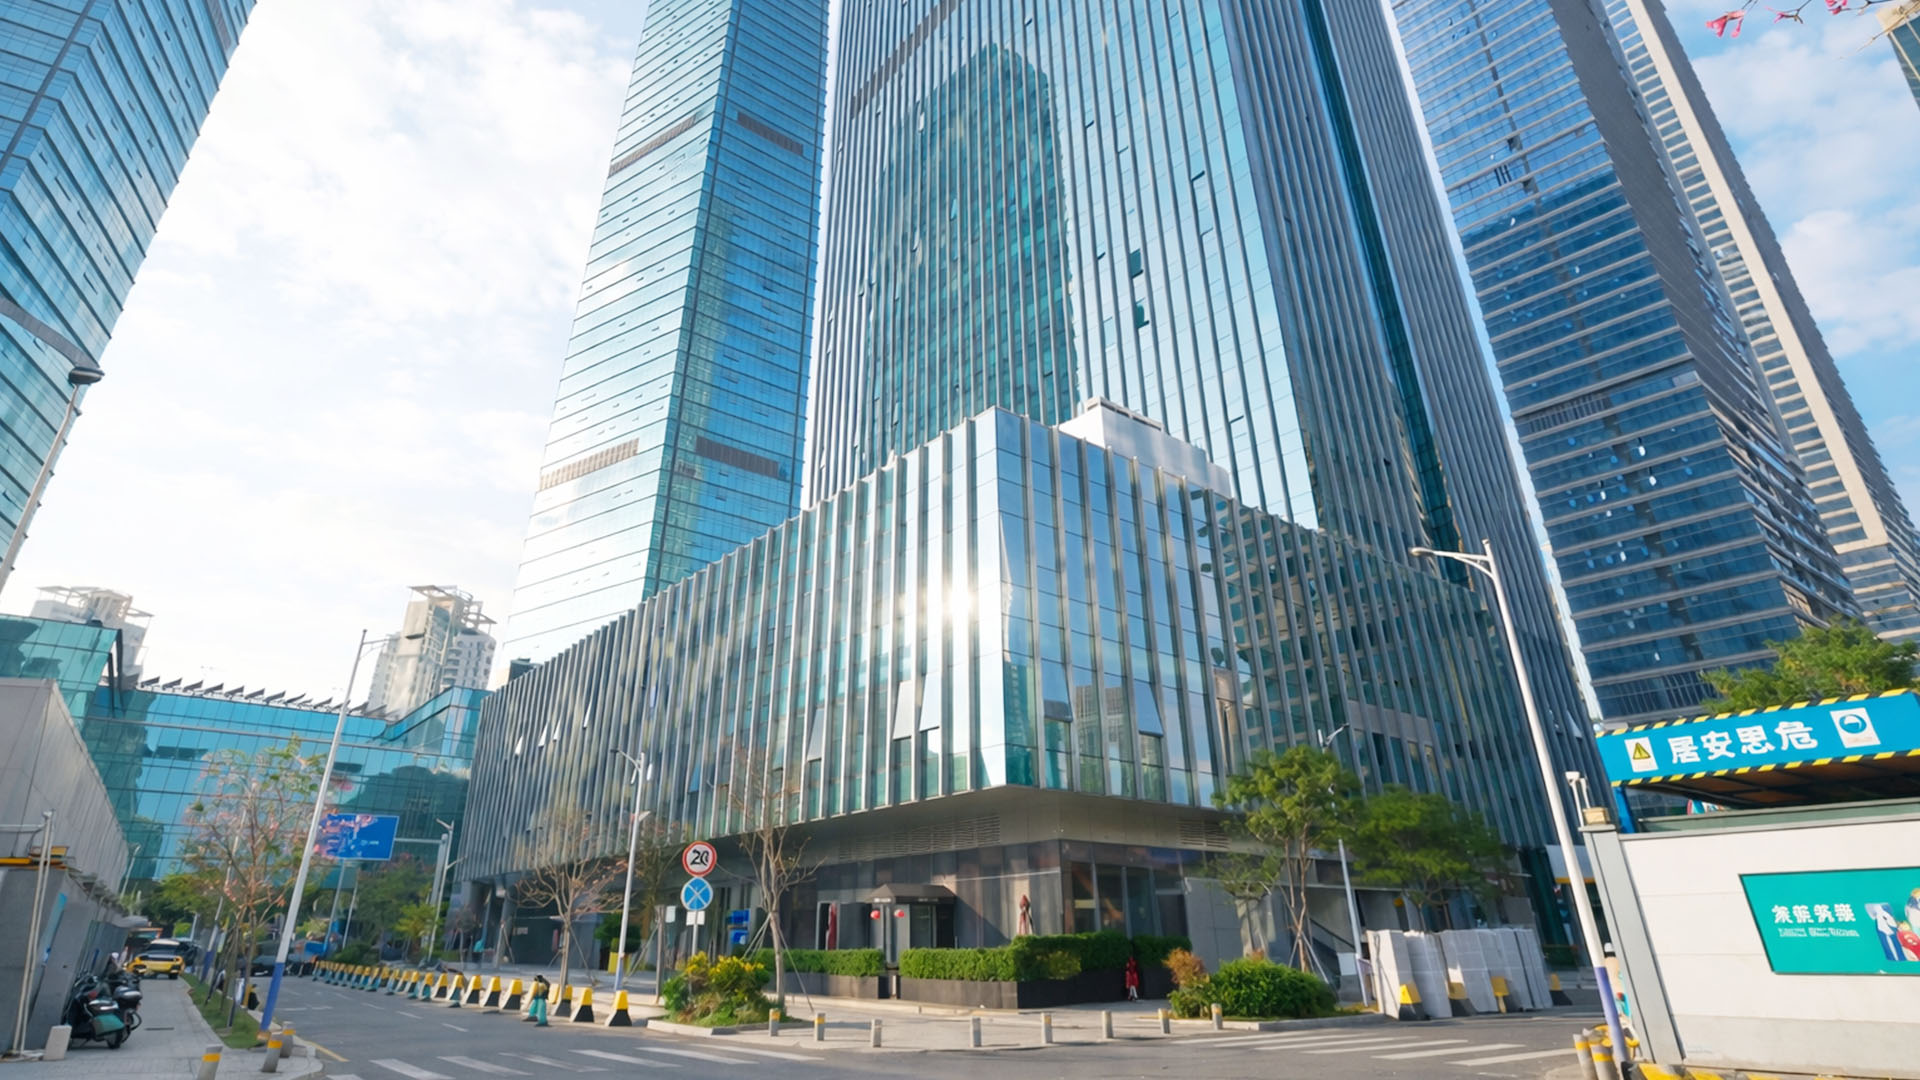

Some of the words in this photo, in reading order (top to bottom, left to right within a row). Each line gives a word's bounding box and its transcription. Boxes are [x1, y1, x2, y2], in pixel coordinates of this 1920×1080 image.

[1667, 721, 1818, 764] 居安思危
[690, 849, 709, 866] 20
